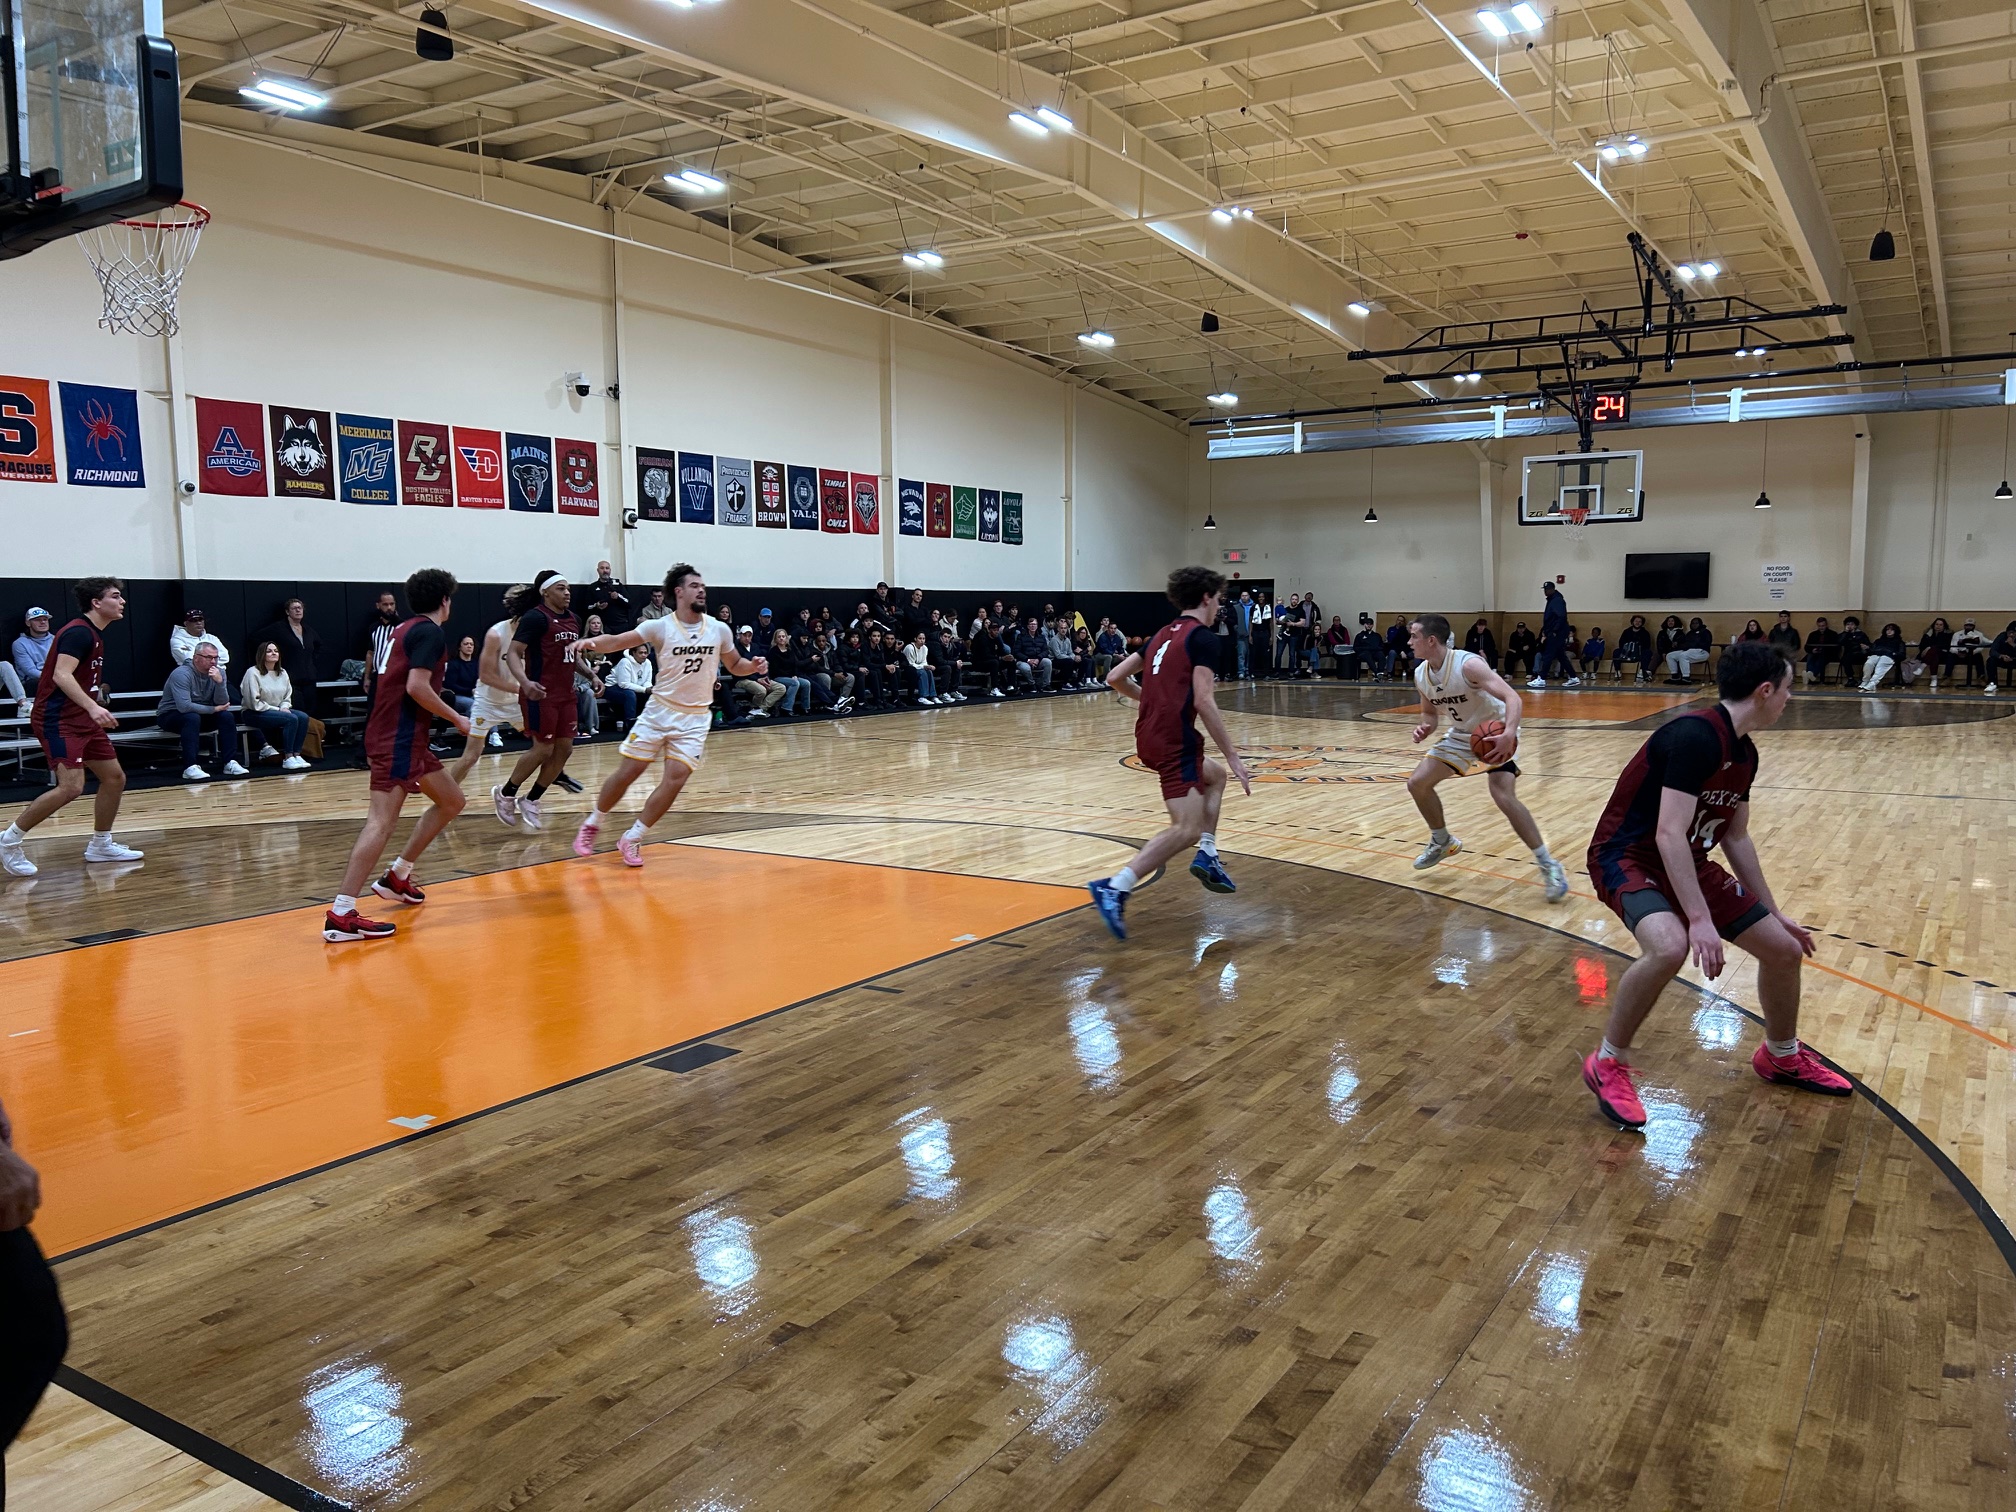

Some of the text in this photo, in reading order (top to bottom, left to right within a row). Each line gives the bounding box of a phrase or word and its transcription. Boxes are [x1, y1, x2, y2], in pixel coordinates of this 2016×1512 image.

[1593, 396, 1625, 421] 24
[339, 425, 393, 440] MERRIMACK
[510, 446, 549, 464] MAINE
[210, 458, 258, 468] AMERICAN
[344, 442, 393, 483] MC
[74, 469, 138, 481] RICHMOND
[681, 466, 713, 487] VILLANOVA
[721, 465, 750, 477] PROVIDENCE
[824, 479, 846, 488] TEMPLE
[351, 488, 389, 501] COLLEGE
[430, 487, 452, 495] COLLEGE
[687, 484, 707, 510] V
[415, 493, 444, 503] EAGLES
[561, 496, 597, 509] HARVARD
[726, 513, 747, 523] FRIARS
[758, 512, 785, 522] BROWN
[792, 510, 818, 519] YALE
[827, 518, 848, 528] OWLS
[672, 645, 715, 656] CHOATE
[1152, 639, 1171, 675] 4
[683, 658, 703, 674] 23
[1430, 695, 1468, 705] CHOATE
[1448, 707, 1462, 721] 2
[1690, 809, 1726, 848] 14
